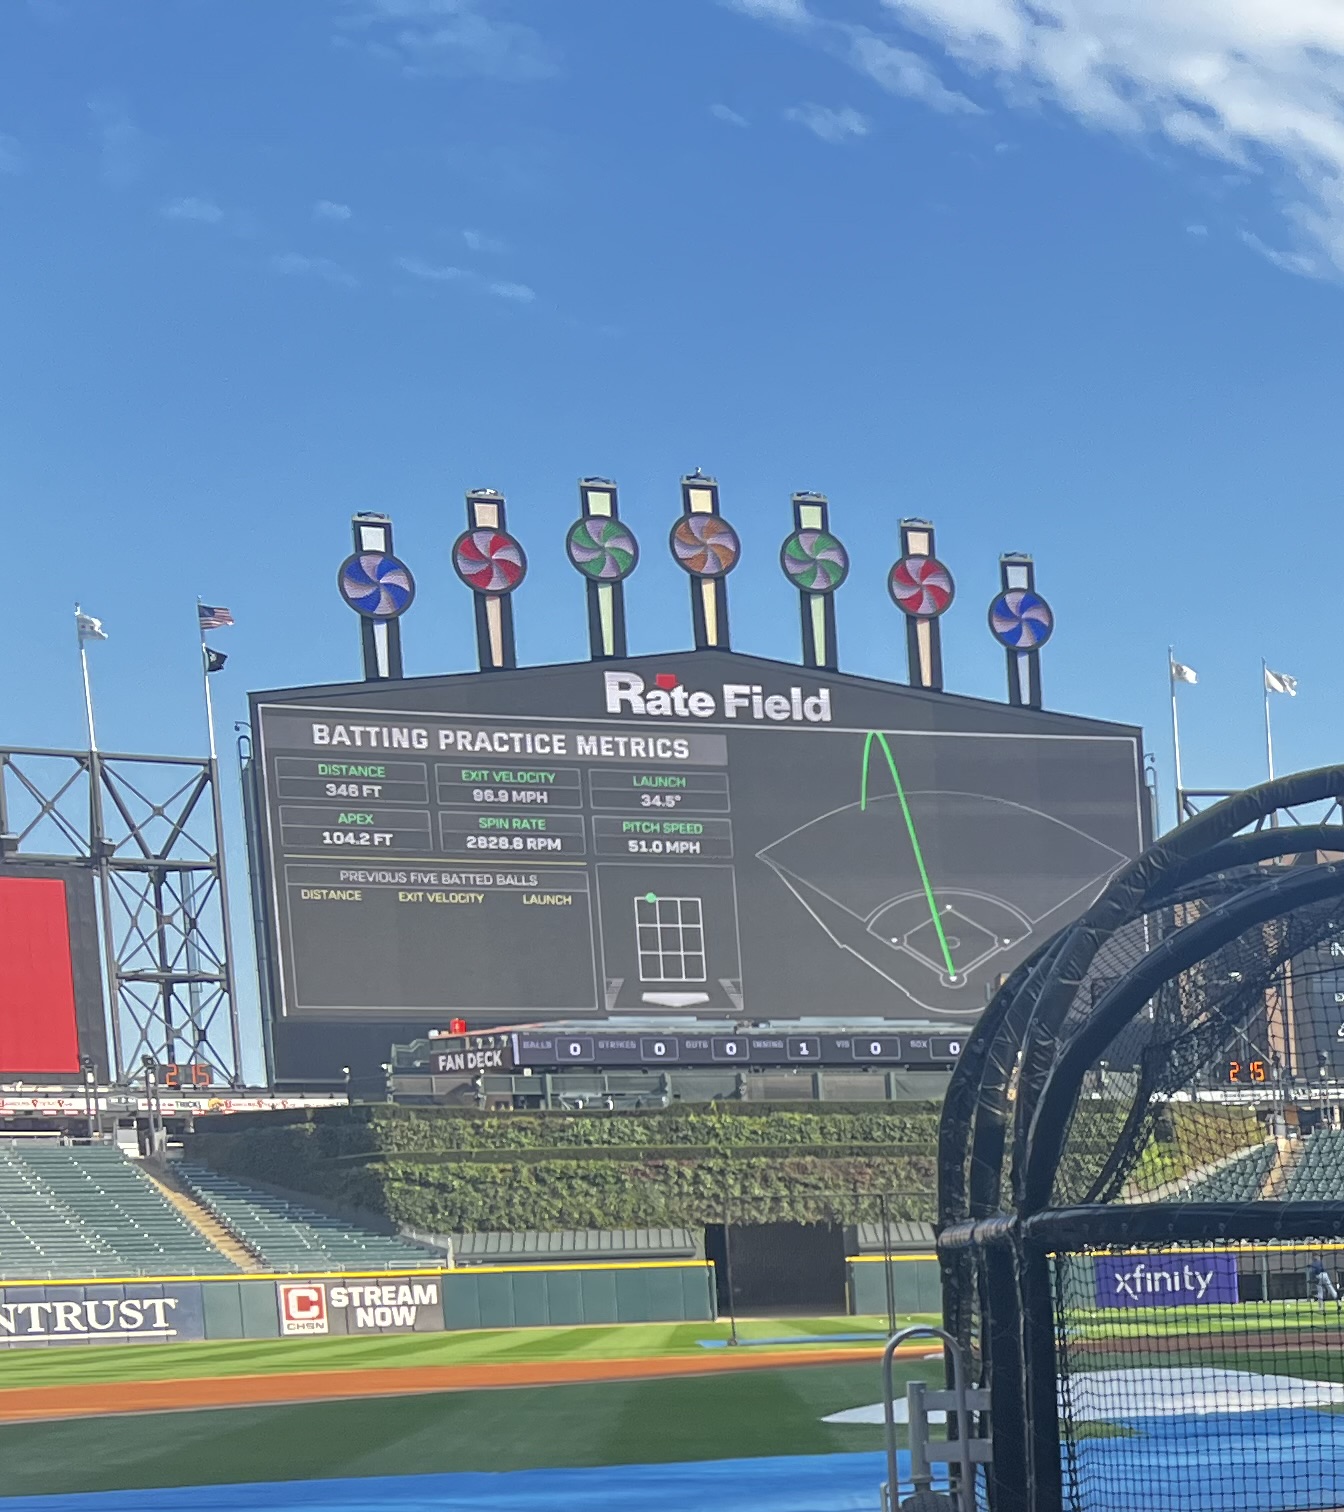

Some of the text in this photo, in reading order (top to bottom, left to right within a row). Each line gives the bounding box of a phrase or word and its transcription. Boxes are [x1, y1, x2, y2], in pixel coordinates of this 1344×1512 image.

[604, 671, 832, 722] Rate Field
[312, 723, 690, 760] BATTING PRACTICE METRICS
[318, 763, 386, 778] DISTANCE
[461, 769, 556, 785] EXIT VELOCITY
[633, 775, 686, 788] LAUNCH
[362, 784, 382, 798] FT
[511, 790, 548, 804] MPH
[338, 812, 374, 825] APEX
[479, 817, 547, 831] SPIN RATE
[622, 821, 703, 835] PITCH SPEED
[322, 831, 393, 846] 104.2 FT
[526, 837, 562, 851] RPM
[628, 840, 701, 854] 51.0 MPH
[340, 870, 538, 887] PREVIOUS FIVE BATTED BALLS
[301, 889, 362, 901] DISTANCE
[399, 891, 485, 904] EXIT VELOCITY
[523, 894, 572, 905] LAUNCH
[570, 1042, 581, 1056] 0
[654, 1042, 666, 1056] 0
[725, 1042, 737, 1056] 0
[800, 1042, 809, 1055] 1
[870, 1042, 881, 1055] 0
[949, 1042, 960, 1055] 0
[438, 1050, 502, 1071] FAN DECK
[1114, 1263, 1214, 1301] xfinity
[331, 1284, 437, 1307] STREAM
[356, 1305, 417, 1328] NOW
[287, 1321, 325, 1332] CHSN
